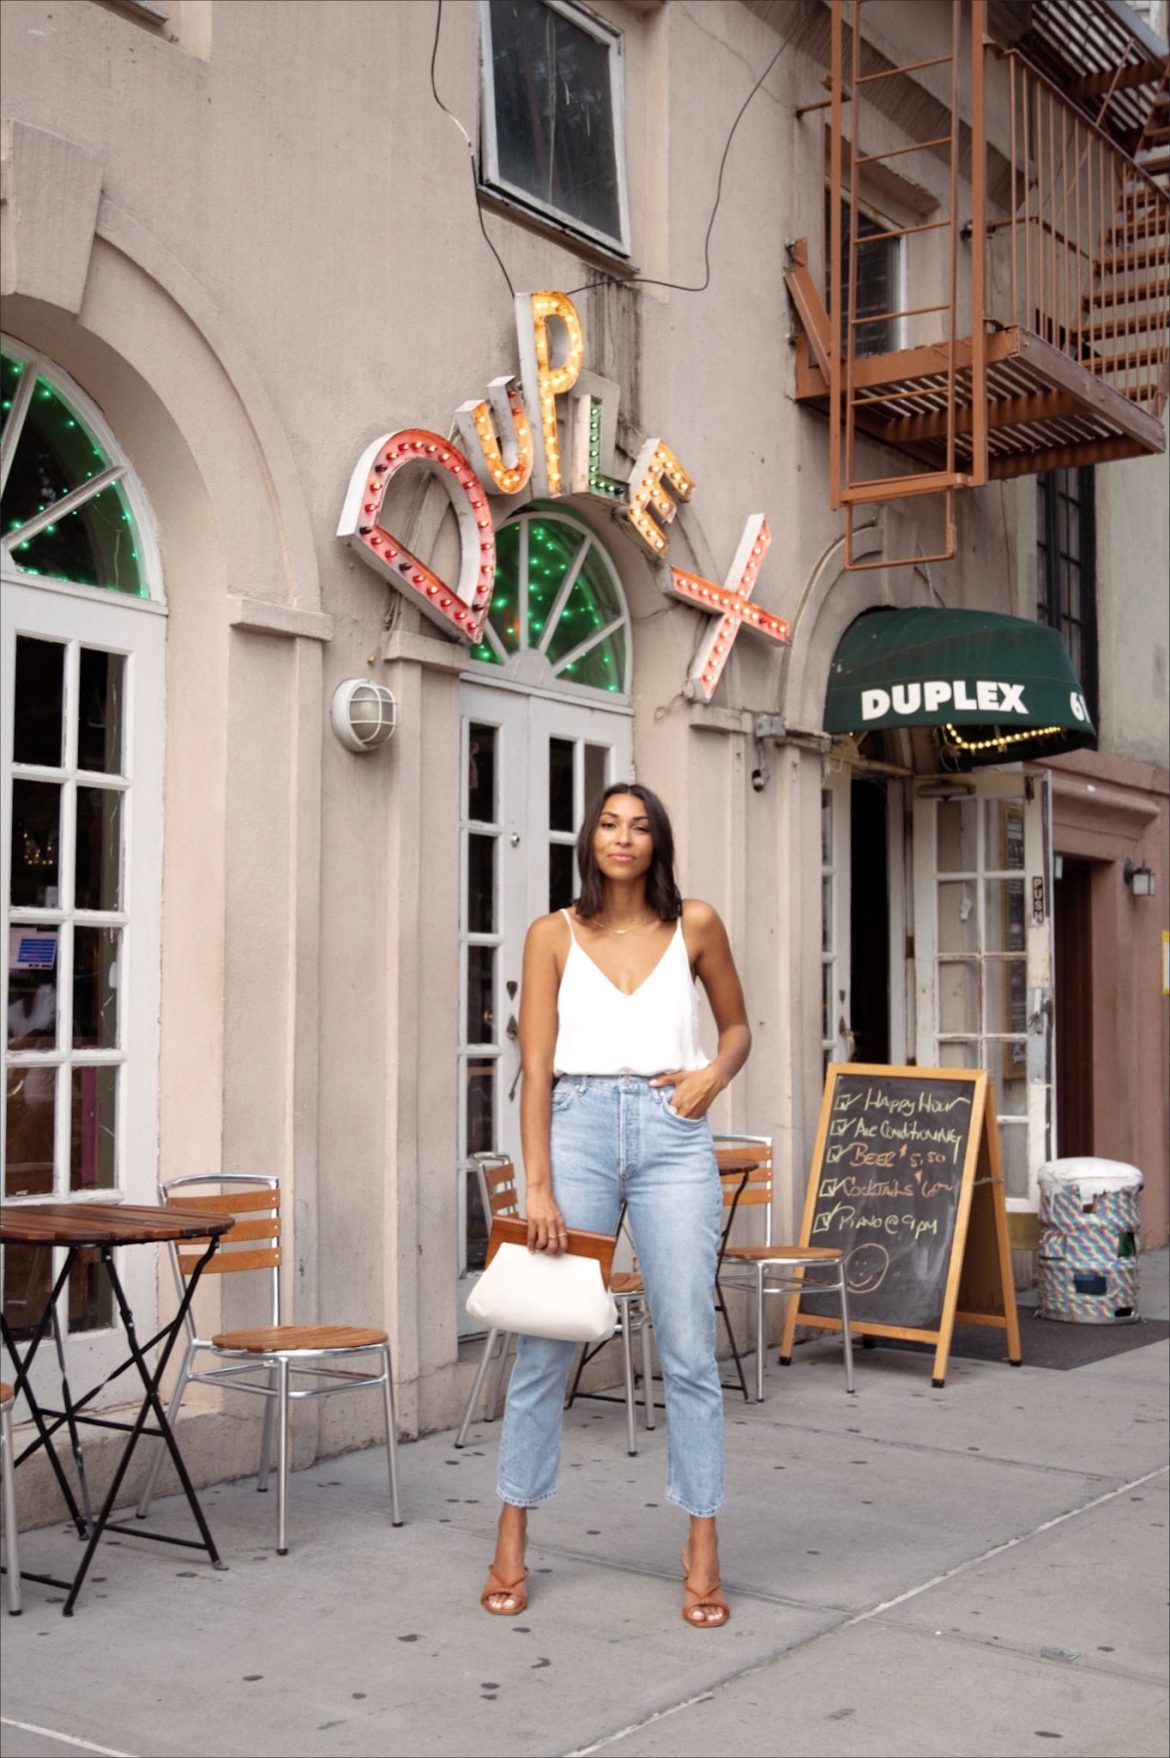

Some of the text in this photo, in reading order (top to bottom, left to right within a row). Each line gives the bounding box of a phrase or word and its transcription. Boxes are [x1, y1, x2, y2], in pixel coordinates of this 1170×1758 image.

[337, 290, 791, 703] DUPLEX
[861, 680, 1029, 721] DUPLEX
[1033, 877, 1044, 923] PUSH
[918, 1091, 971, 1113] Hour
[849, 1142, 896, 1167] BEER
